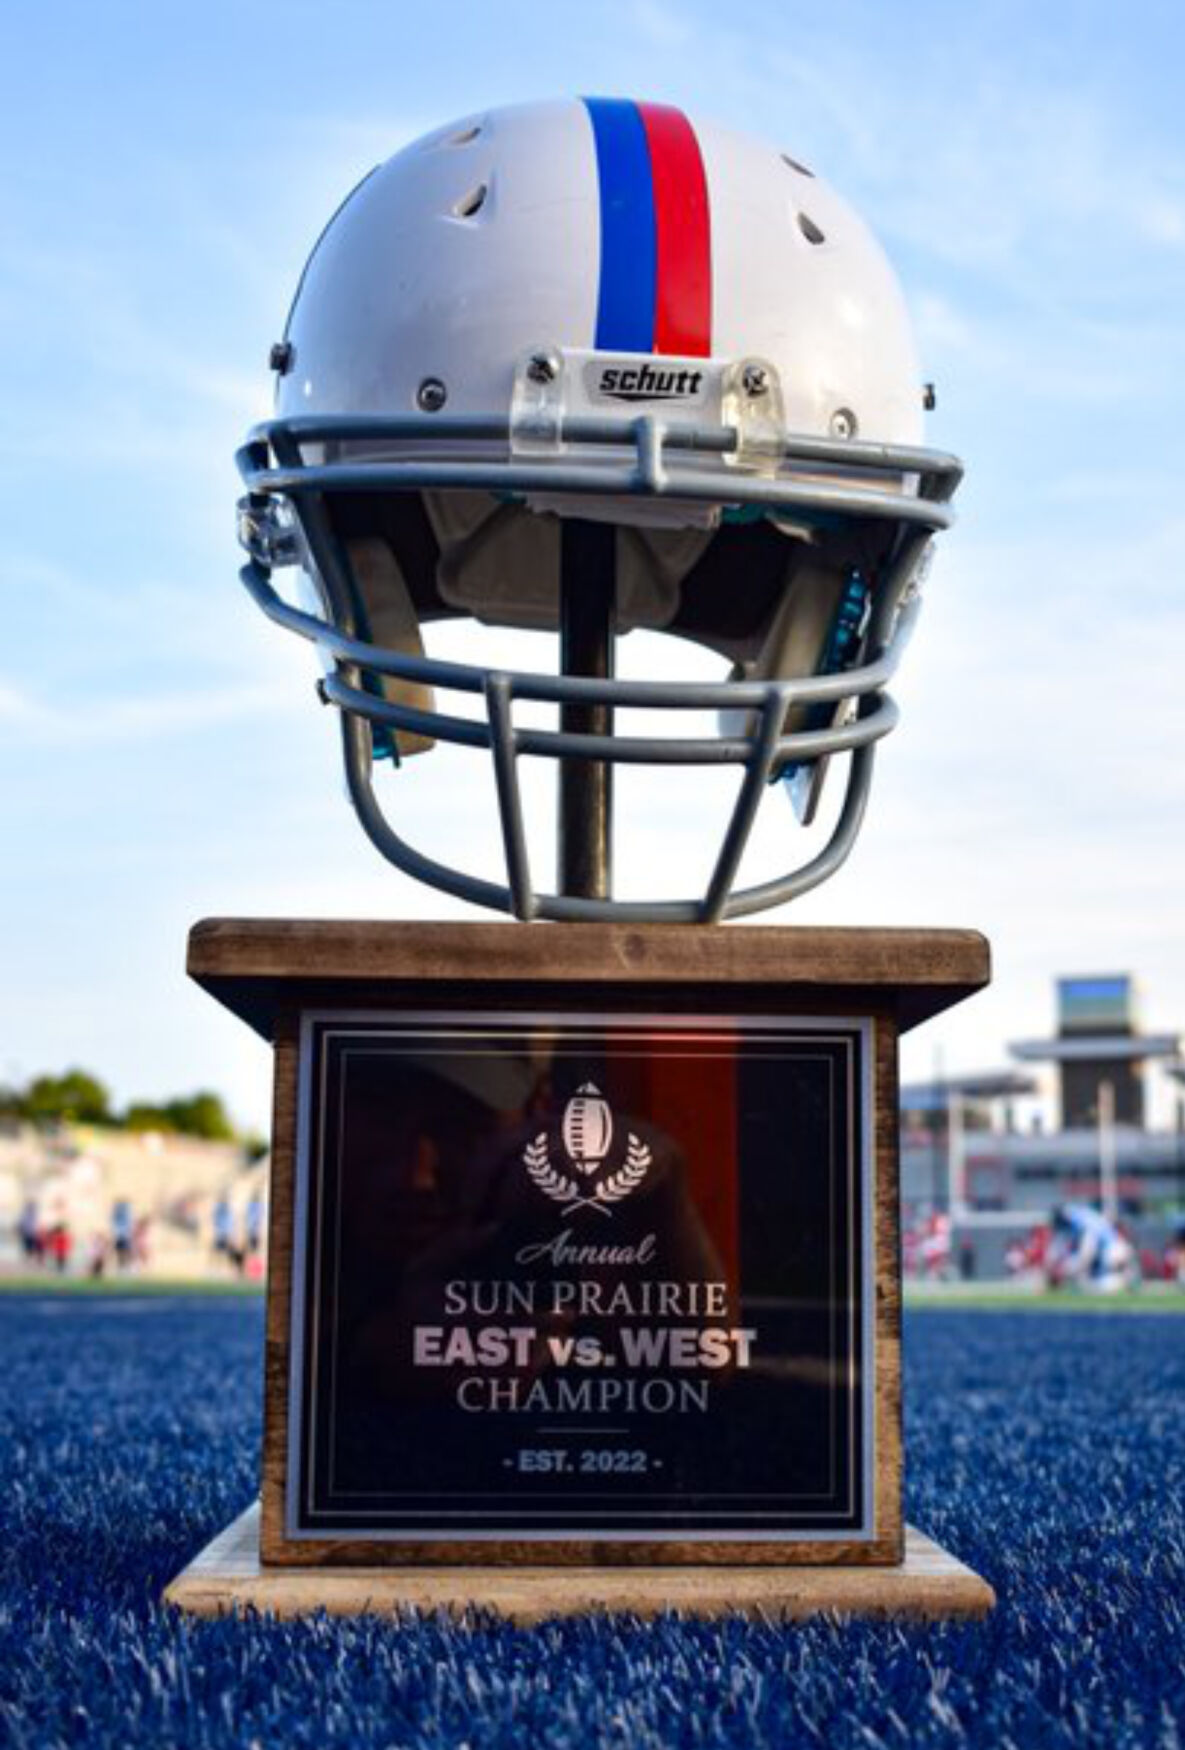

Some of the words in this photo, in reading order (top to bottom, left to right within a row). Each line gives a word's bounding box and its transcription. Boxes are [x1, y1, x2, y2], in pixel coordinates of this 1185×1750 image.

[600, 364, 703, 394] schutt
[515, 1229, 657, 1266] Annual
[445, 1281, 536, 1315] SUN
[552, 1281, 729, 1316] PRAIRIE
[413, 1327, 536, 1367] EAST
[547, 1336, 617, 1368] vs.
[621, 1329, 757, 1368] WEST
[456, 1378, 710, 1413] CHAMPION
[518, 1451, 574, 1472] EST.
[580, 1451, 647, 1472] 2022
